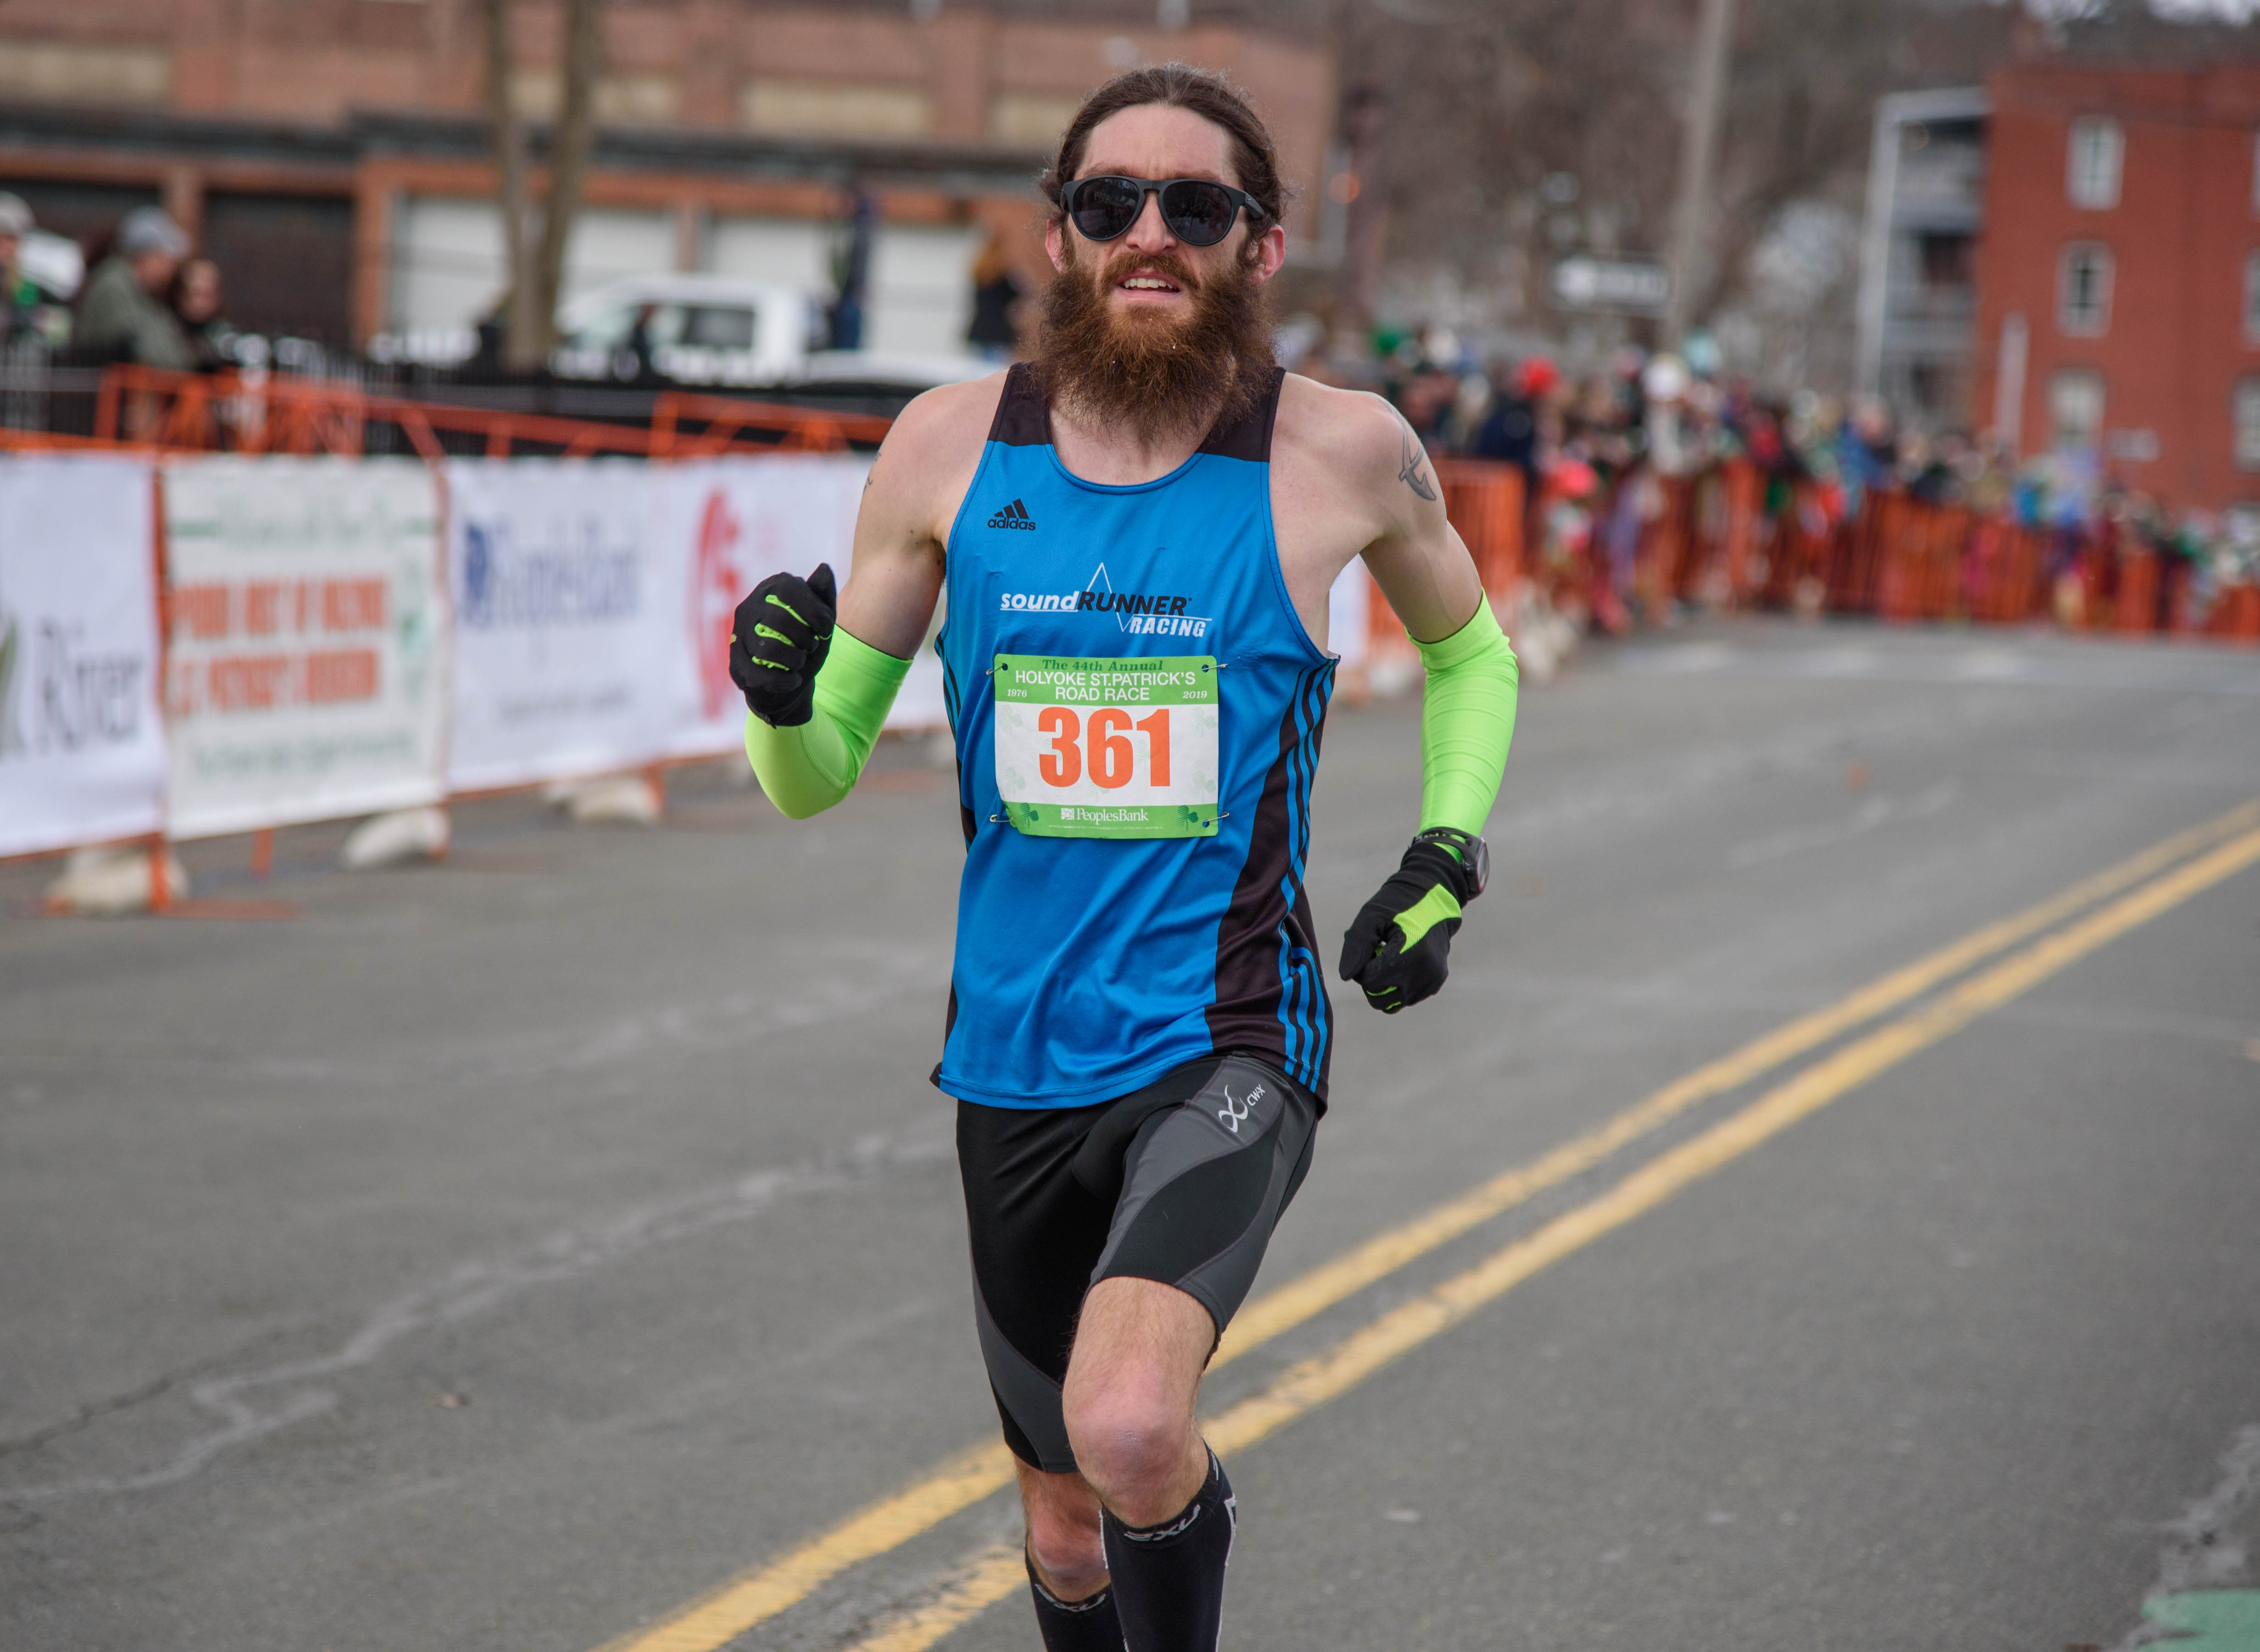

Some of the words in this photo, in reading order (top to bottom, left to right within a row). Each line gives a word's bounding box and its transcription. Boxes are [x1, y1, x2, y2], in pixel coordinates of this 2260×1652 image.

[987, 517, 1036, 531] adidas
[1129, 617, 1206, 637] RACING
[1043, 659, 1068, 670] The
[1072, 661, 1103, 671] 44th
[1108, 660, 1164, 671] Annual
[1015, 670, 1086, 686] HOLYOKE
[1090, 671, 1196, 687] ST.PATRICK'S
[1007, 688, 1027, 698] 1976
[1055, 687, 1100, 700] ROAD
[1105, 687, 1150, 701] RACE
[1182, 691, 1208, 699] 2019
[1038, 706, 1171, 789] 361
[1076, 808, 1149, 826] PeoplesBank
